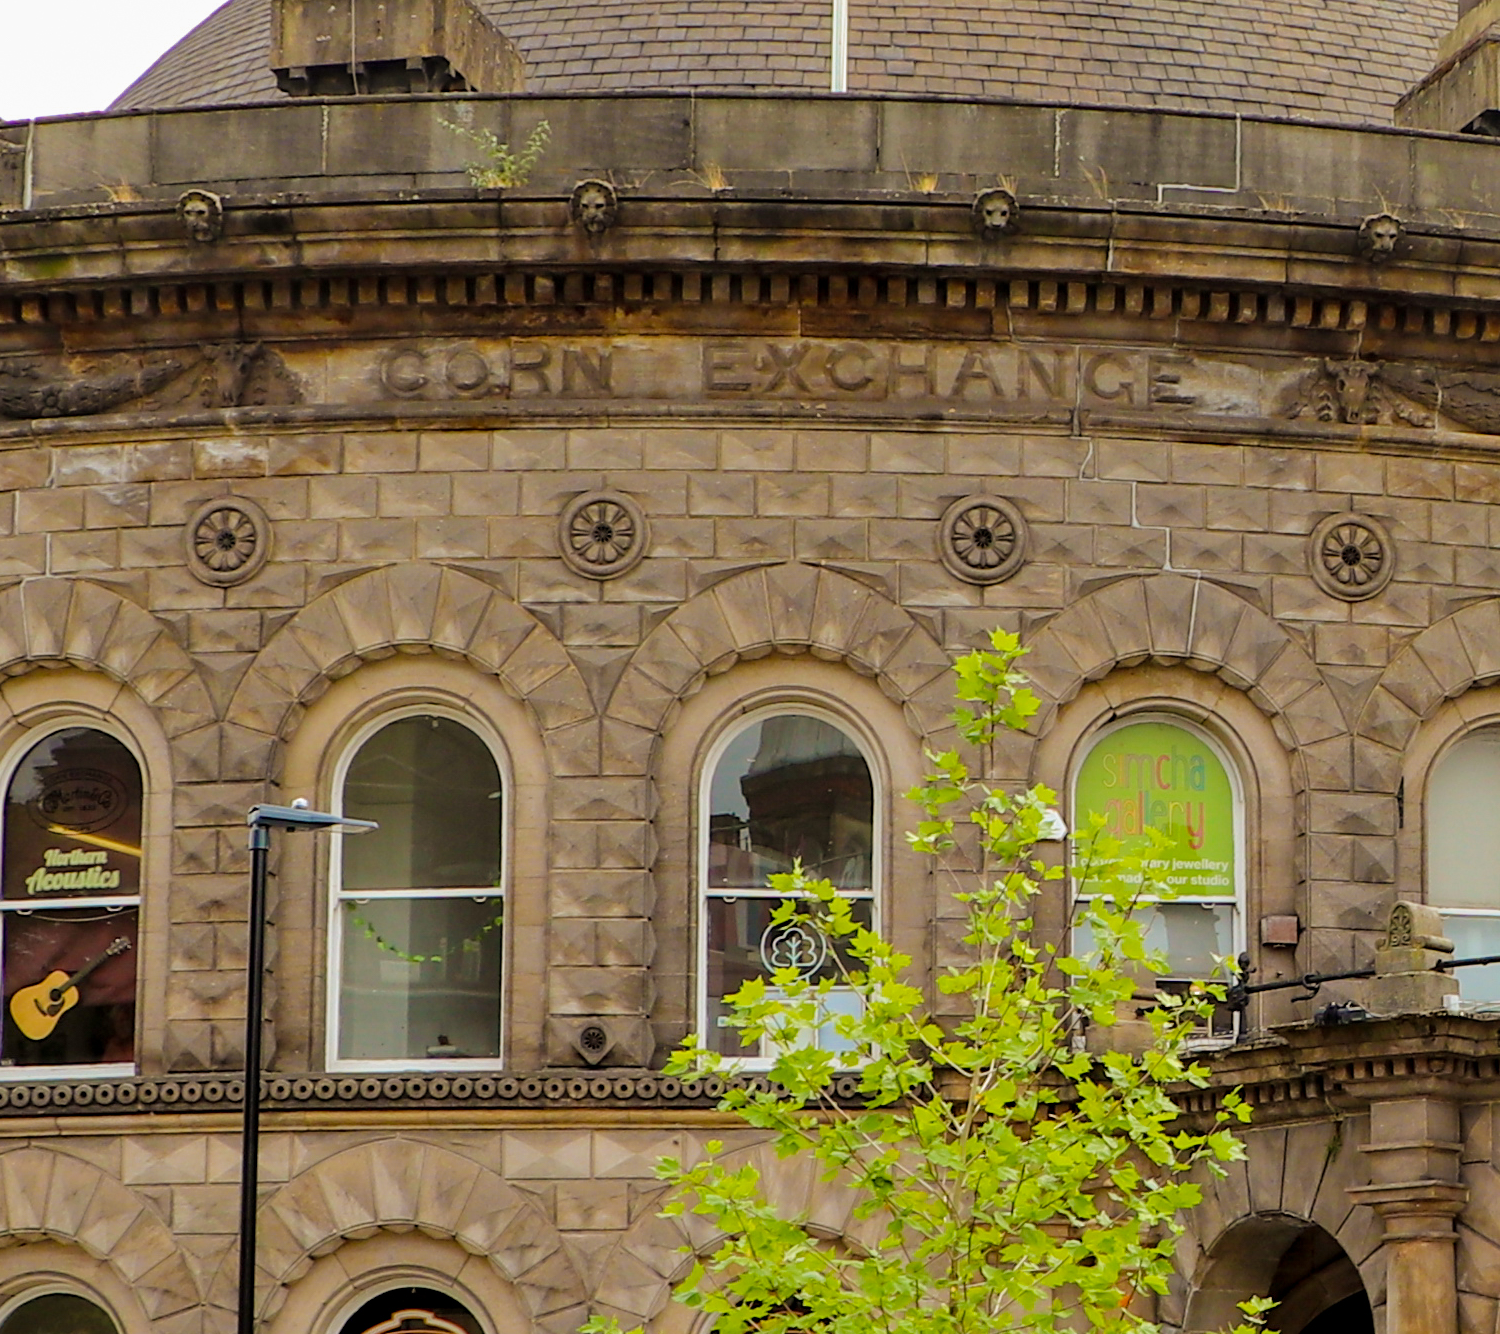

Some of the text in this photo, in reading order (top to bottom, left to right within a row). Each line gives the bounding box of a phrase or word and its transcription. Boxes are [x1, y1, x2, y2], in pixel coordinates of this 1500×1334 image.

[378, 340, 1198, 408] CORN EXCHANGE
[1103, 745, 1205, 791] simcha
[1104, 791, 1204, 850] gallery
[43, 847, 108, 867] Northern
[1172, 859, 1229, 872] jewellery
[25, 866, 121, 895] Acoustics
[1166, 874, 1229, 886] our studio
